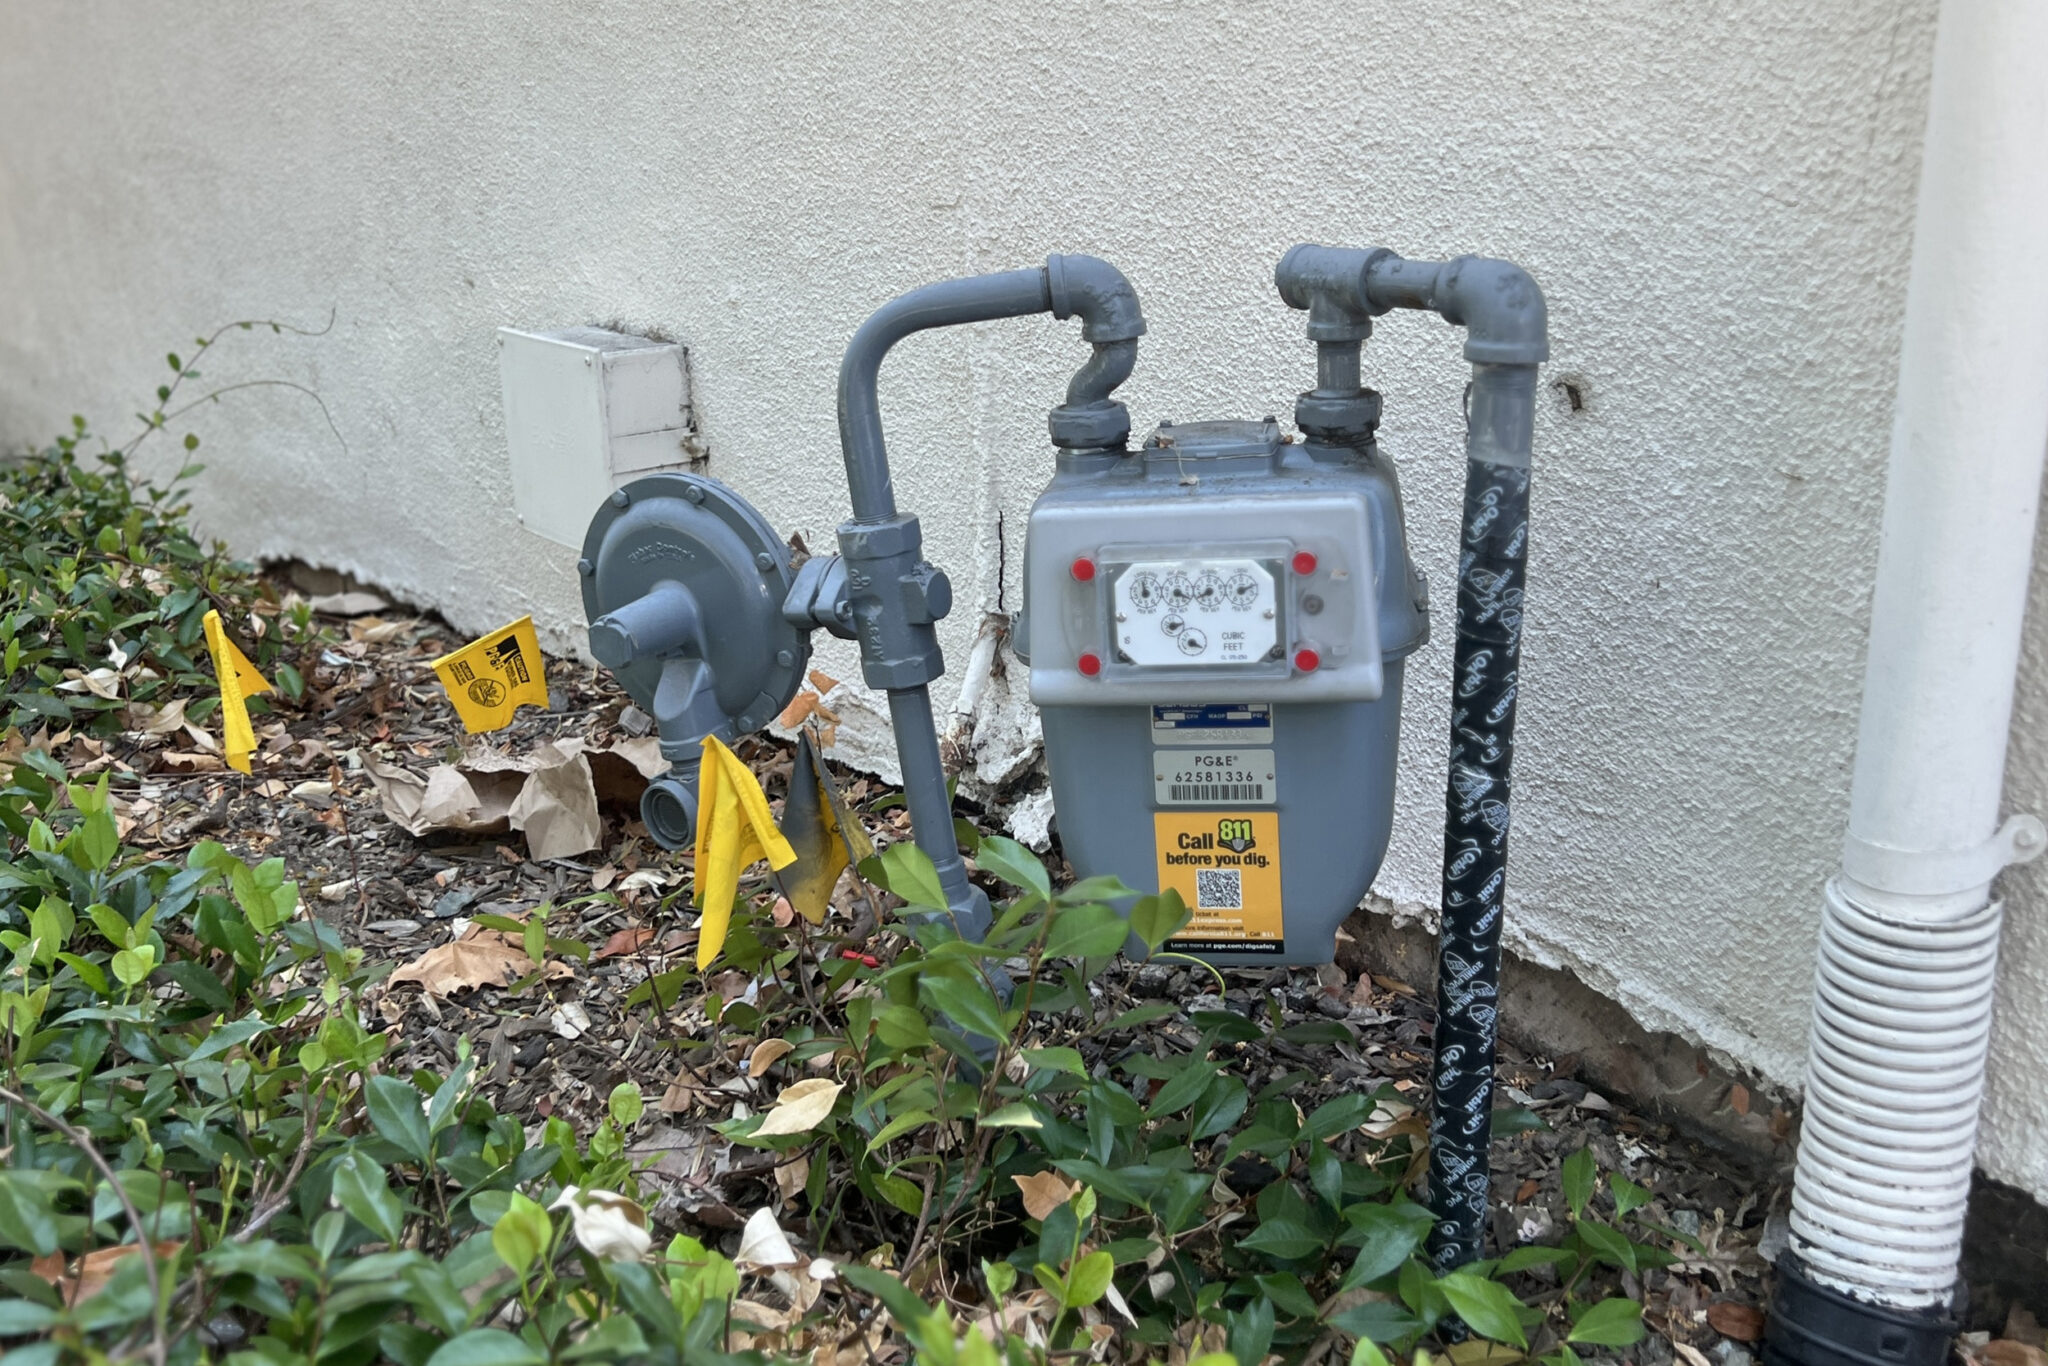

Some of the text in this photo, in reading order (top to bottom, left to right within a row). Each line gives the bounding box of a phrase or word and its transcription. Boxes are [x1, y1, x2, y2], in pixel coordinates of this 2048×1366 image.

[1504, 528, 1524, 558] Orbit
[1221, 631, 1245, 640] CUBIC
[1223, 642, 1243, 651] FEET
[1492, 688, 1516, 718] Orbit
[1175, 771, 1254, 783] 62581336
[1178, 820, 1251, 849] Call 811
[1166, 852, 1270, 868] before you dig.
[1450, 852, 1476, 875] Orbit
[1477, 873, 1502, 902] Orbit
[1464, 1085, 1489, 1112] Orbit
